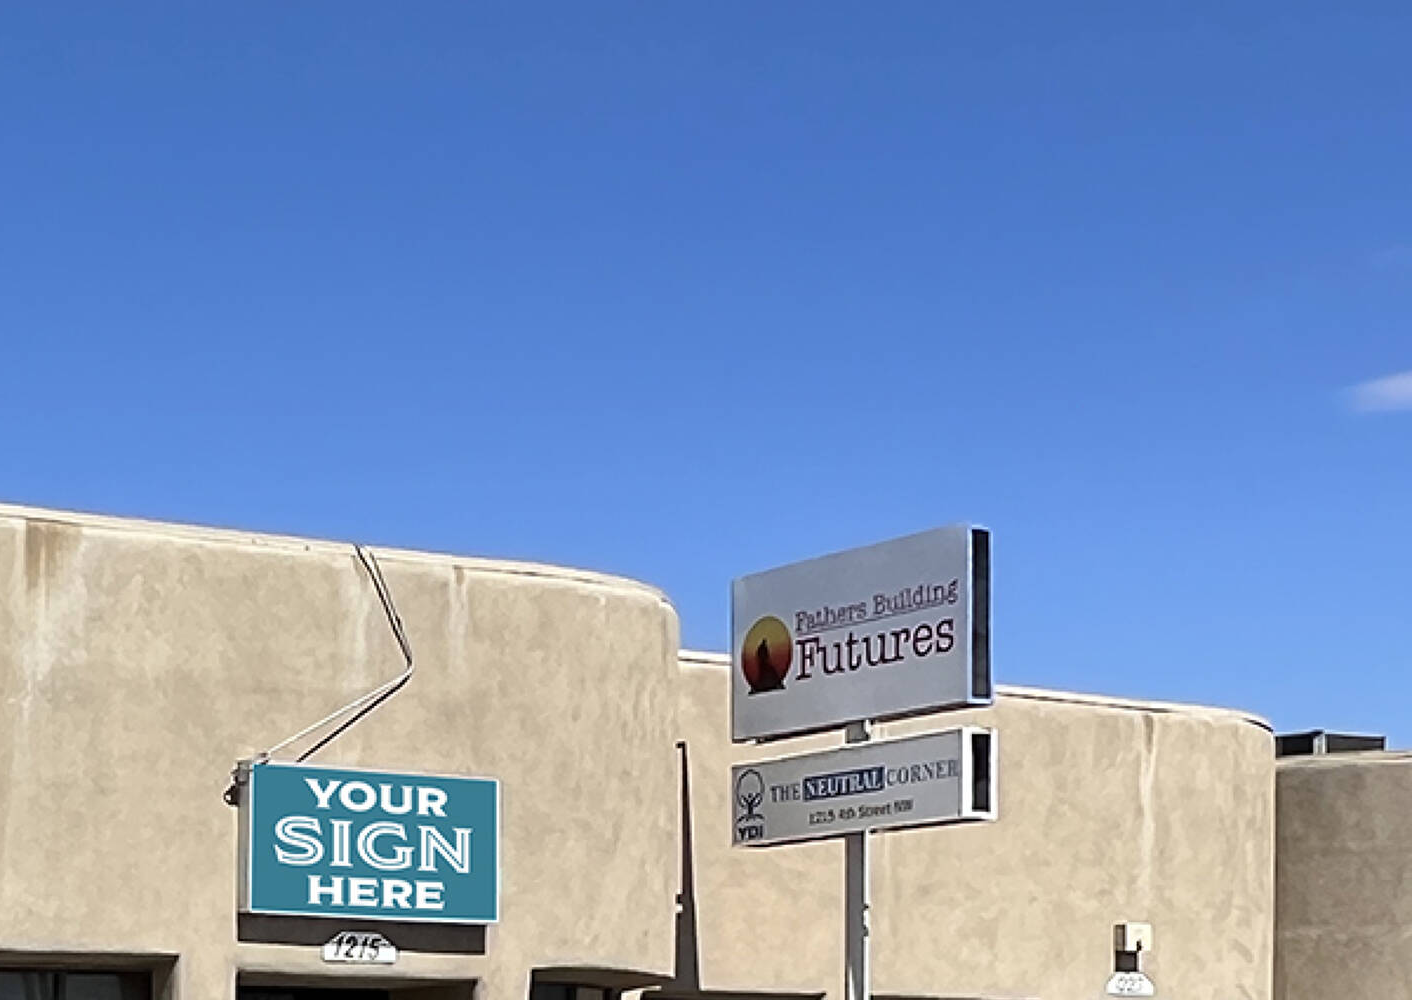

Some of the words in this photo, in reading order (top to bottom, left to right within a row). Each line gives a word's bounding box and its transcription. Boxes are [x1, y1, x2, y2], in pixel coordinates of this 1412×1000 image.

[795, 602, 867, 633] Fathers
[872, 577, 959, 615] Building
[794, 617, 955, 681] Futures
[303, 777, 448, 818] YOUR
[769, 783, 801, 803] THE
[805, 769, 882, 798] NEUTRAL
[886, 759, 959, 787] CORNER
[857, 803, 892, 819] Street
[273, 815, 474, 874] SIGN
[307, 874, 446, 911] HERE
[332, 934, 383, 961] 1215
